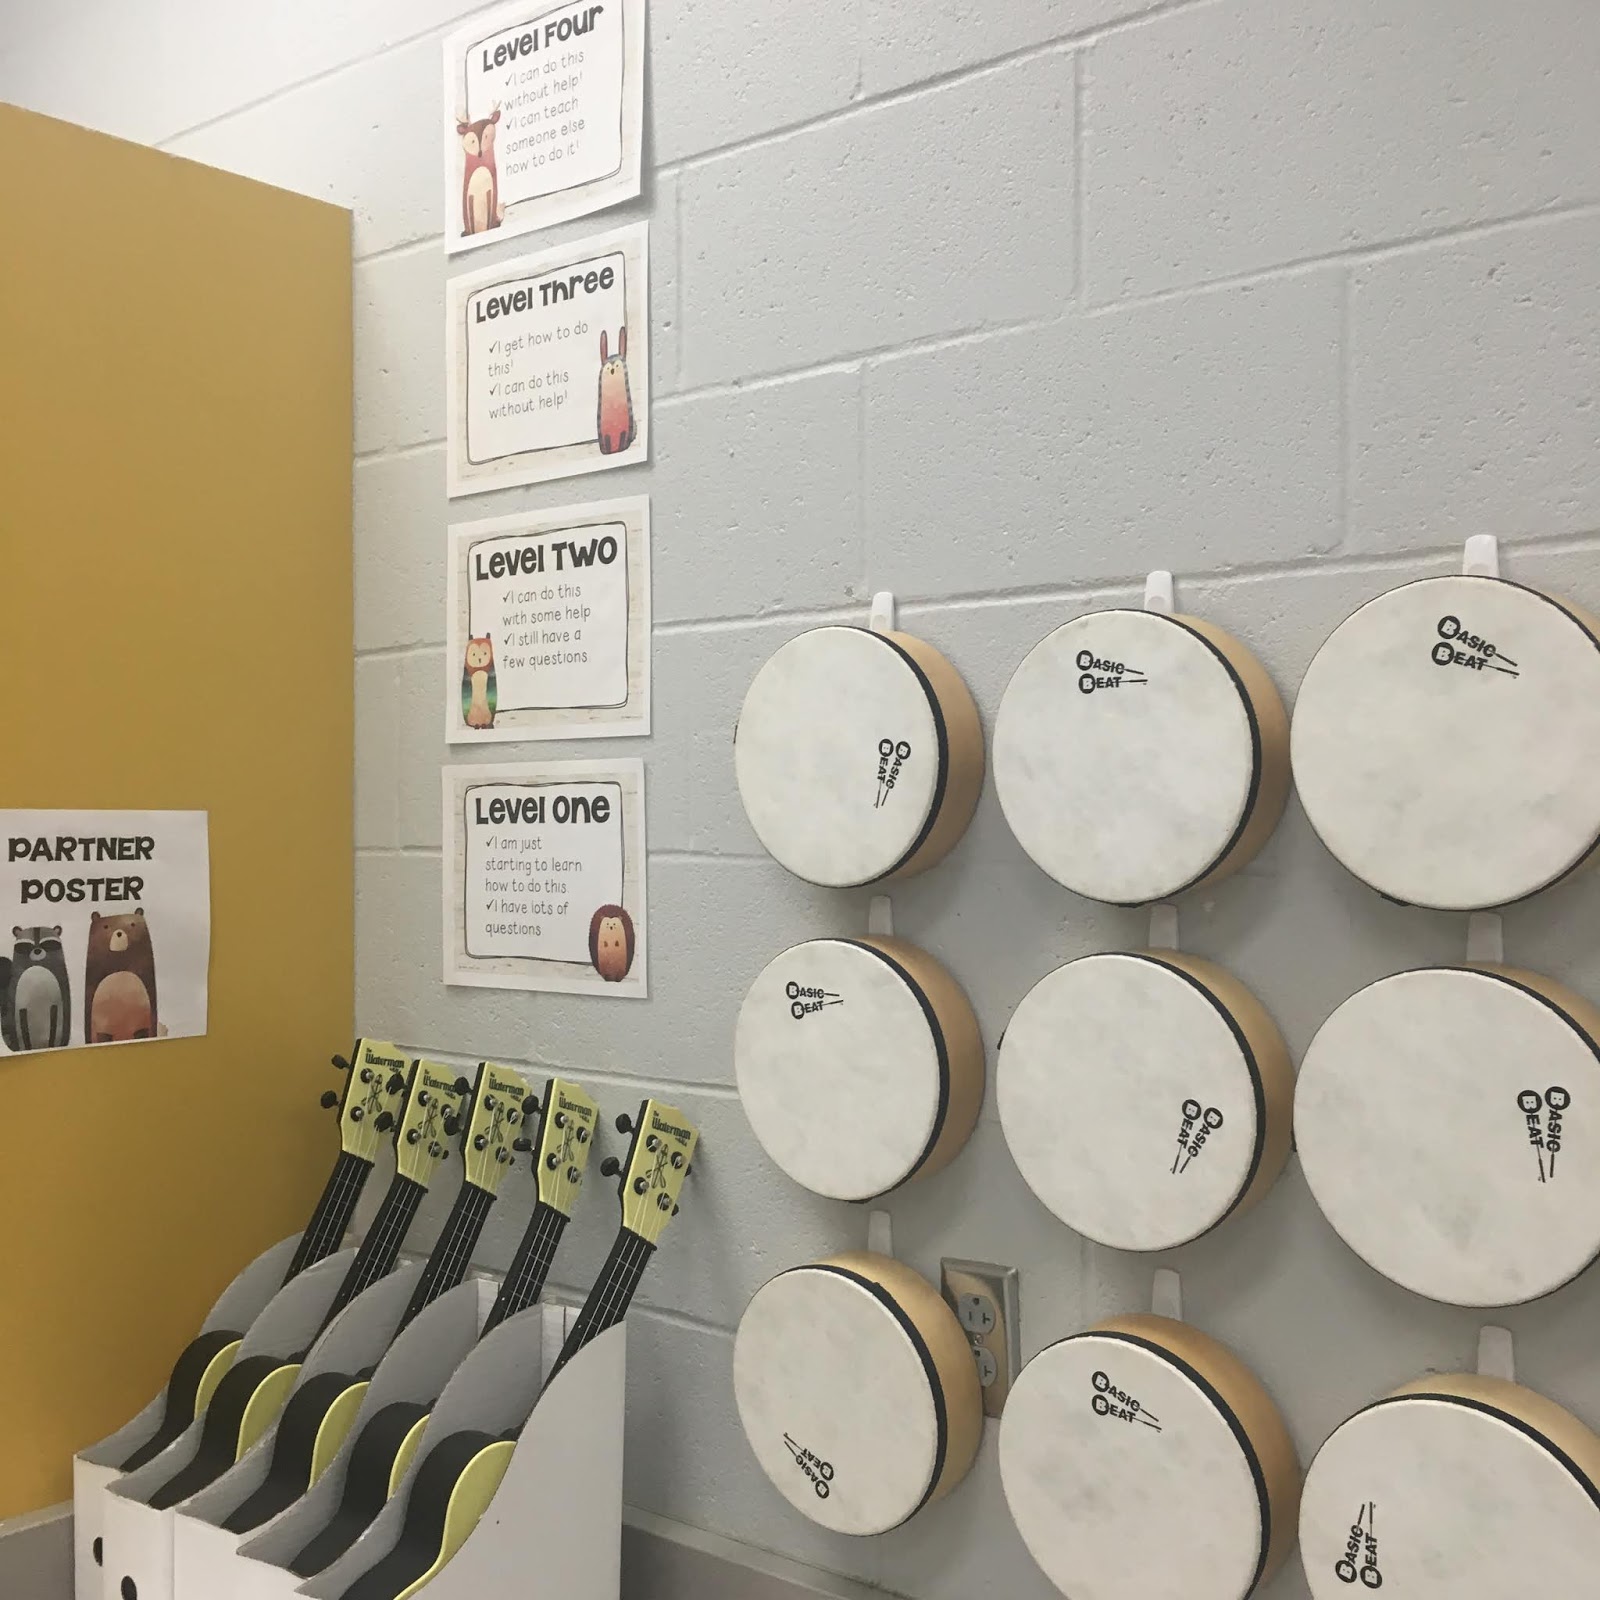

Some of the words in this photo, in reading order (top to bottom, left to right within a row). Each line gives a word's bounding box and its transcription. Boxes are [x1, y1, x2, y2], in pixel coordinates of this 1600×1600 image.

[483, 28, 539, 73] Level
[545, 5, 604, 48] Four
[520, 68, 540, 84] can
[543, 60, 557, 74] do
[561, 51, 584, 69] this
[504, 82, 549, 111] without
[553, 72, 583, 95] help!
[520, 111, 541, 128] can
[544, 97, 578, 119] teach
[506, 128, 557, 155] someone
[561, 118, 585, 136] else
[506, 159, 529, 176] how
[532, 152, 545, 168] to
[549, 145, 562, 161] do
[476, 287, 533, 324] Level
[539, 266, 614, 306] Three
[504, 335, 523, 357] get
[528, 331, 552, 346] how
[556, 326, 570, 340] to
[574, 320, 588, 335] do
[488, 359, 514, 377] this!
[504, 380, 525, 395] can
[528, 375, 543, 389] do
[546, 370, 569, 385] this
[489, 398, 535, 419] without
[538, 390, 568, 410] help!
[475, 545, 545, 581] Level
[517, 591, 537, 604] can
[541, 586, 554, 600] do
[558, 583, 581, 599] this
[502, 611, 527, 626] with
[531, 609, 561, 624] some
[565, 604, 591, 623] help
[518, 631, 538, 647] still
[542, 630, 570, 644] have
[574, 630, 581, 640] a
[503, 655, 525, 669] few
[475, 796, 546, 825] Level
[8, 836, 155, 862] PARTNER
[501, 839, 517, 850] am
[520, 836, 542, 854] just
[485, 857, 532, 876] starting
[535, 858, 548, 871] to
[552, 857, 582, 872] learn
[21, 876, 144, 904] POSTER
[485, 878, 508, 892] how
[512, 878, 524, 892] to
[528, 878, 541, 892] do
[501, 899, 527, 914] have
[532, 900, 553, 915] lots
[557, 901, 569, 915] of
[365, 1053, 405, 1068] Waterman
[489, 1078, 524, 1096] Waterman
[559, 1097, 592, 1117] Waterman
[652, 1117, 691, 1140] Waterman
